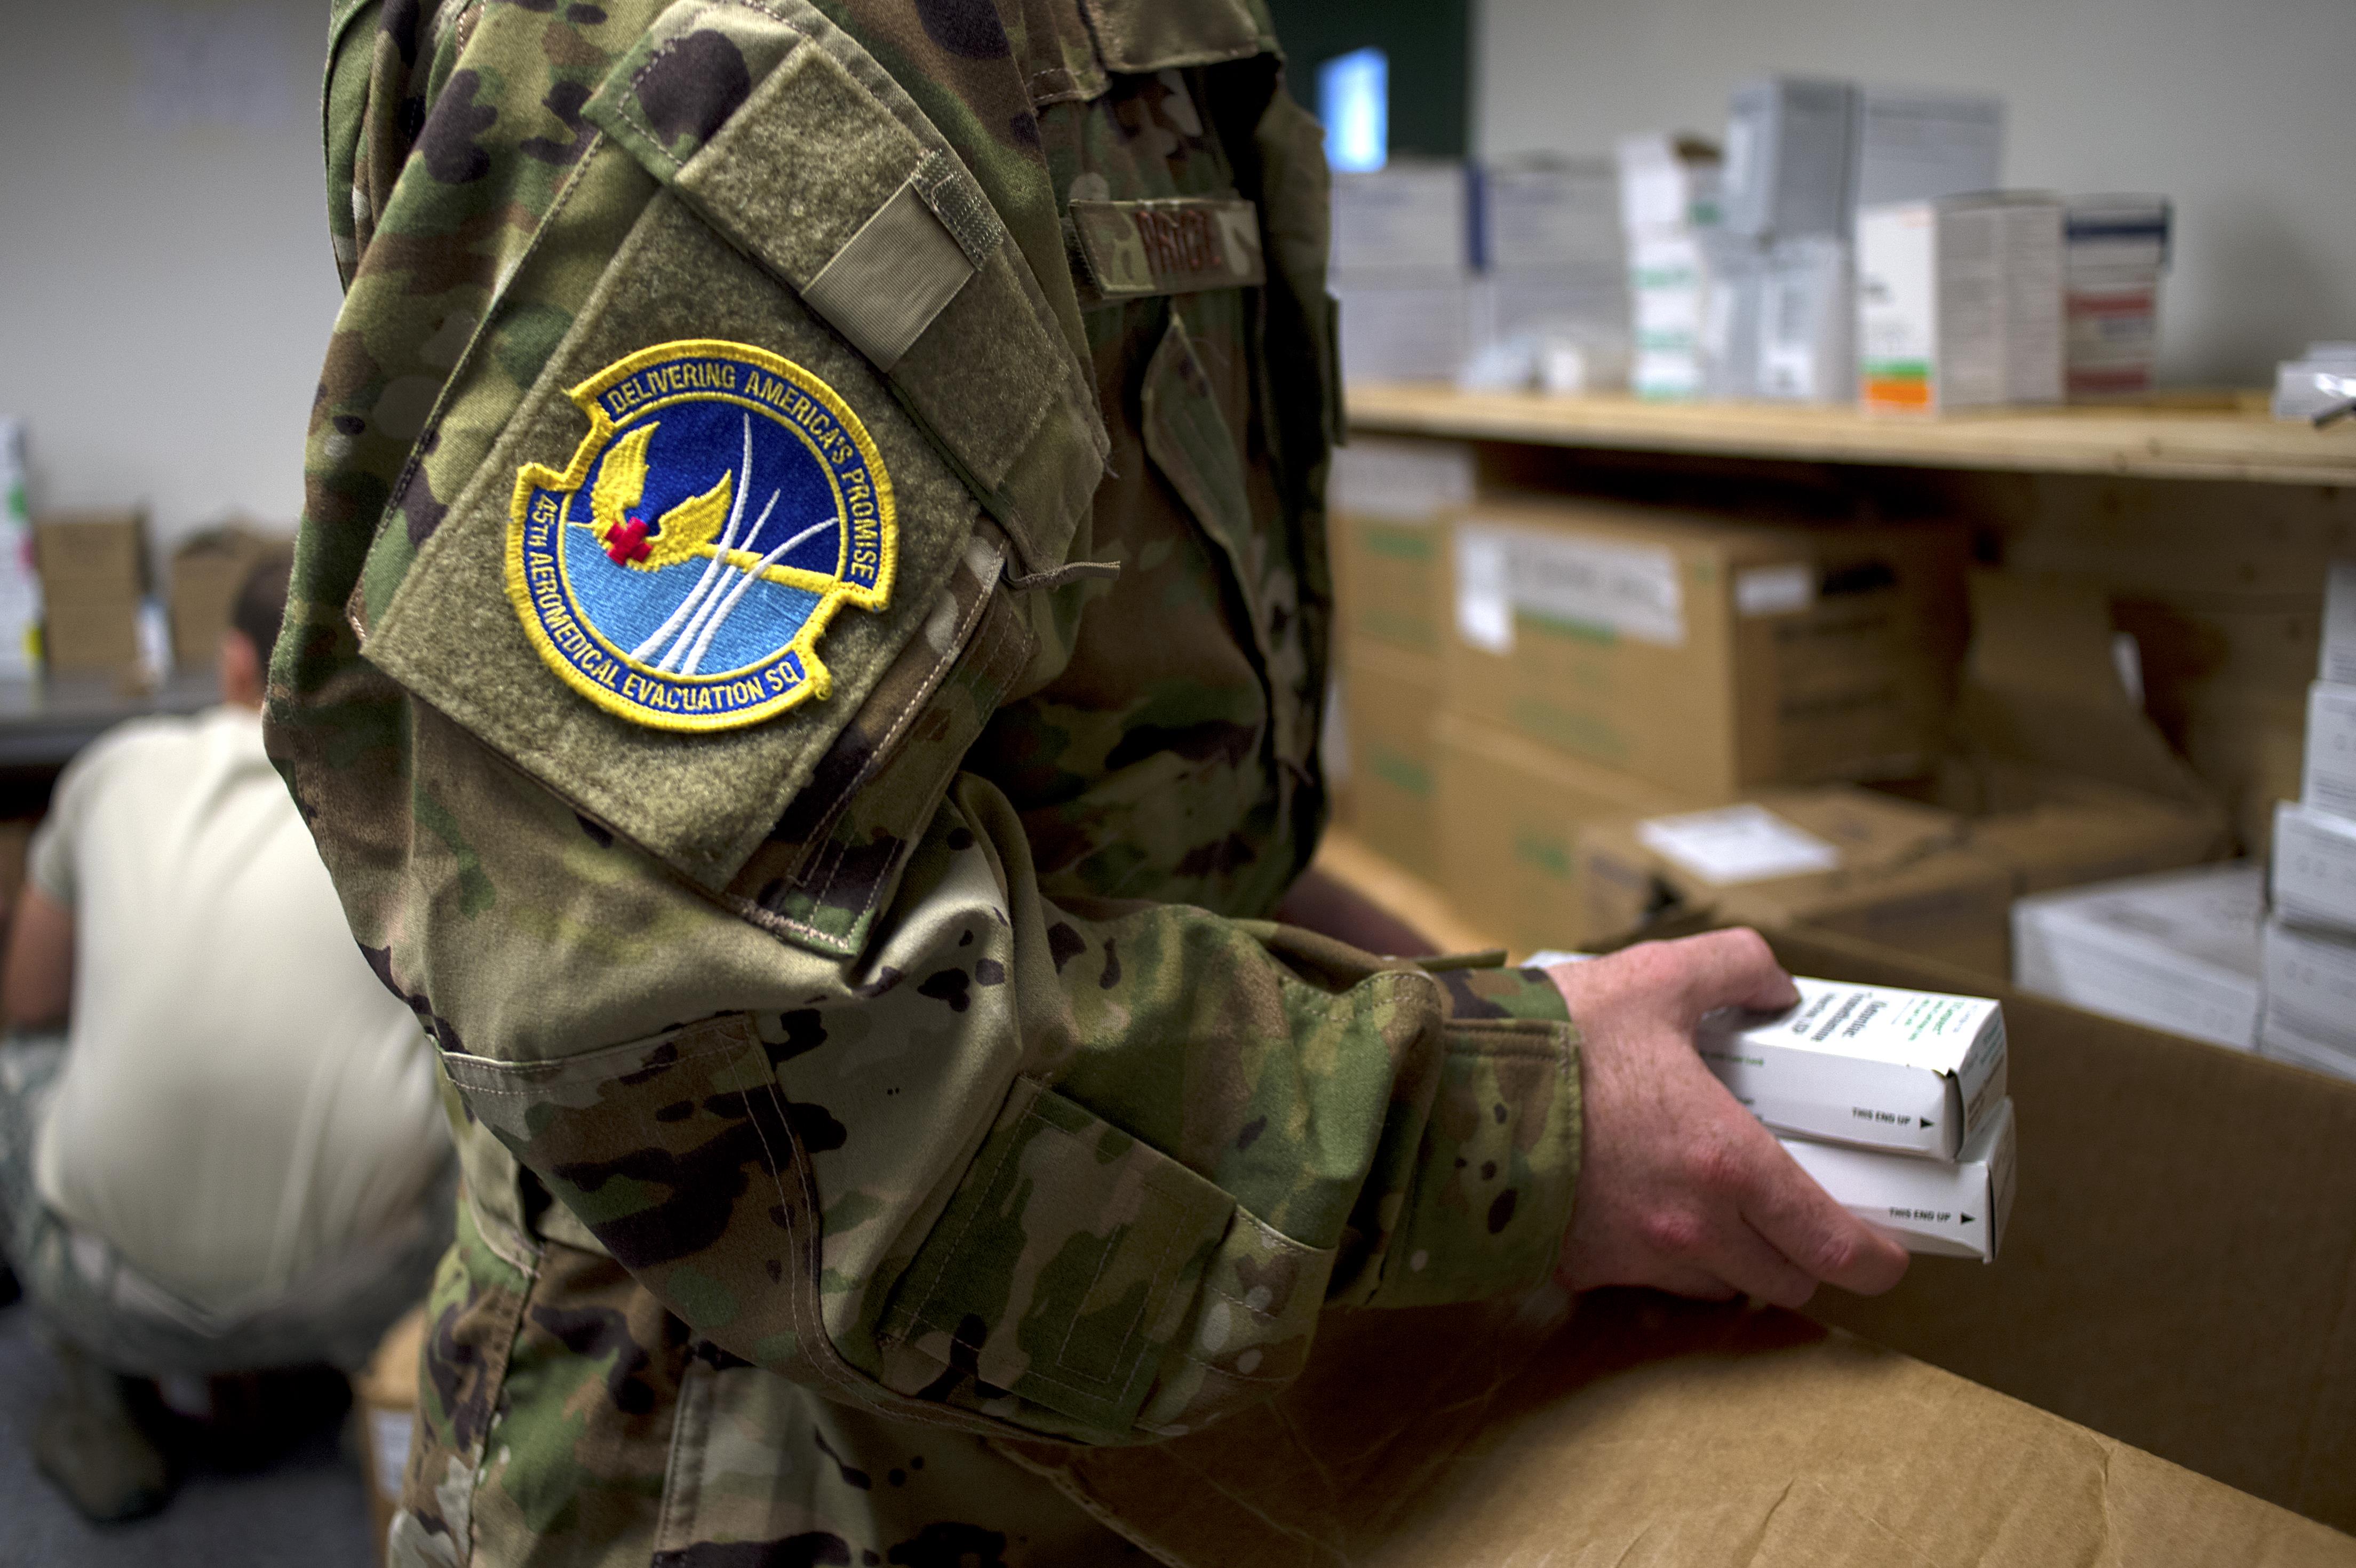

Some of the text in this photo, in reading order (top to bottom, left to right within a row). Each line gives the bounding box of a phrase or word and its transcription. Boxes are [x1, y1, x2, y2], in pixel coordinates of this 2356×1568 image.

[607, 362, 878, 580] DELIVERING AMERICA'S PROMISE
[527, 493, 801, 711] 45TH AEROMEDICAL EVACUATION SQ
[1852, 1107, 1912, 1126] THIS END UP
[1890, 1206, 1952, 1223] THIS END UP
